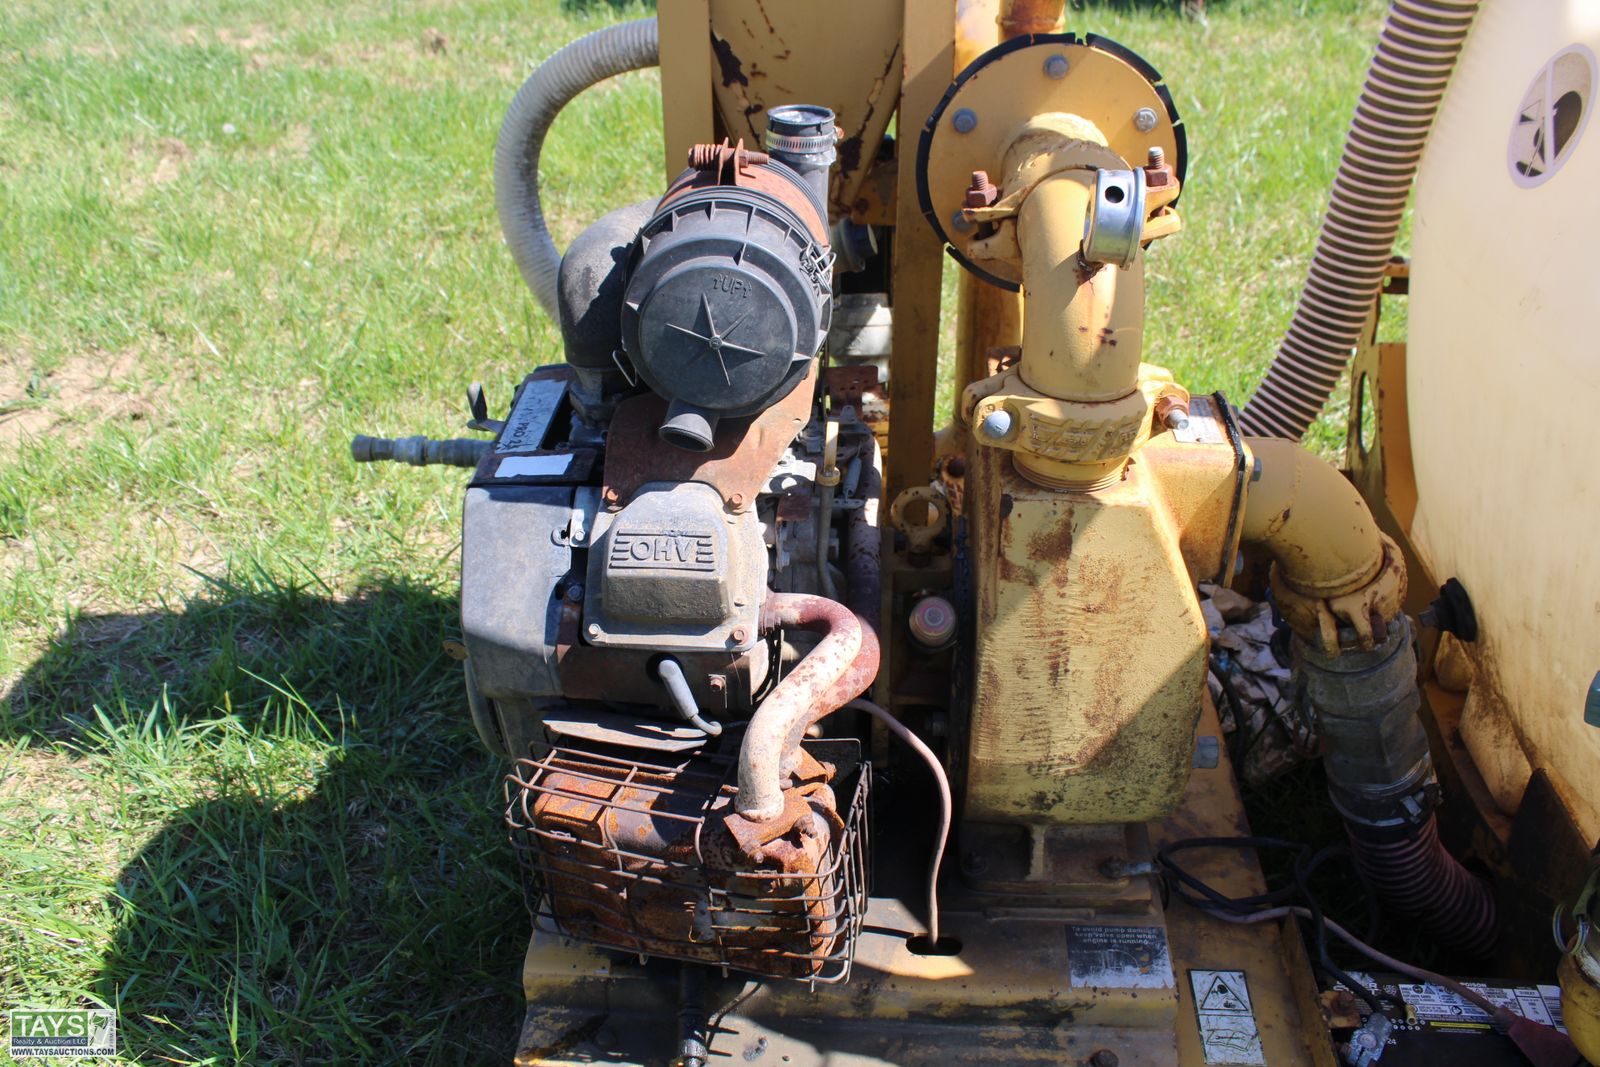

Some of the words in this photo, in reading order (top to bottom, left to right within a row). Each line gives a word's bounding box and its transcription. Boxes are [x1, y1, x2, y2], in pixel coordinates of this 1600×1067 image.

[721, 274, 744, 295] UP
[513, 422, 530, 438] PRO
[630, 538, 691, 562] OHV
